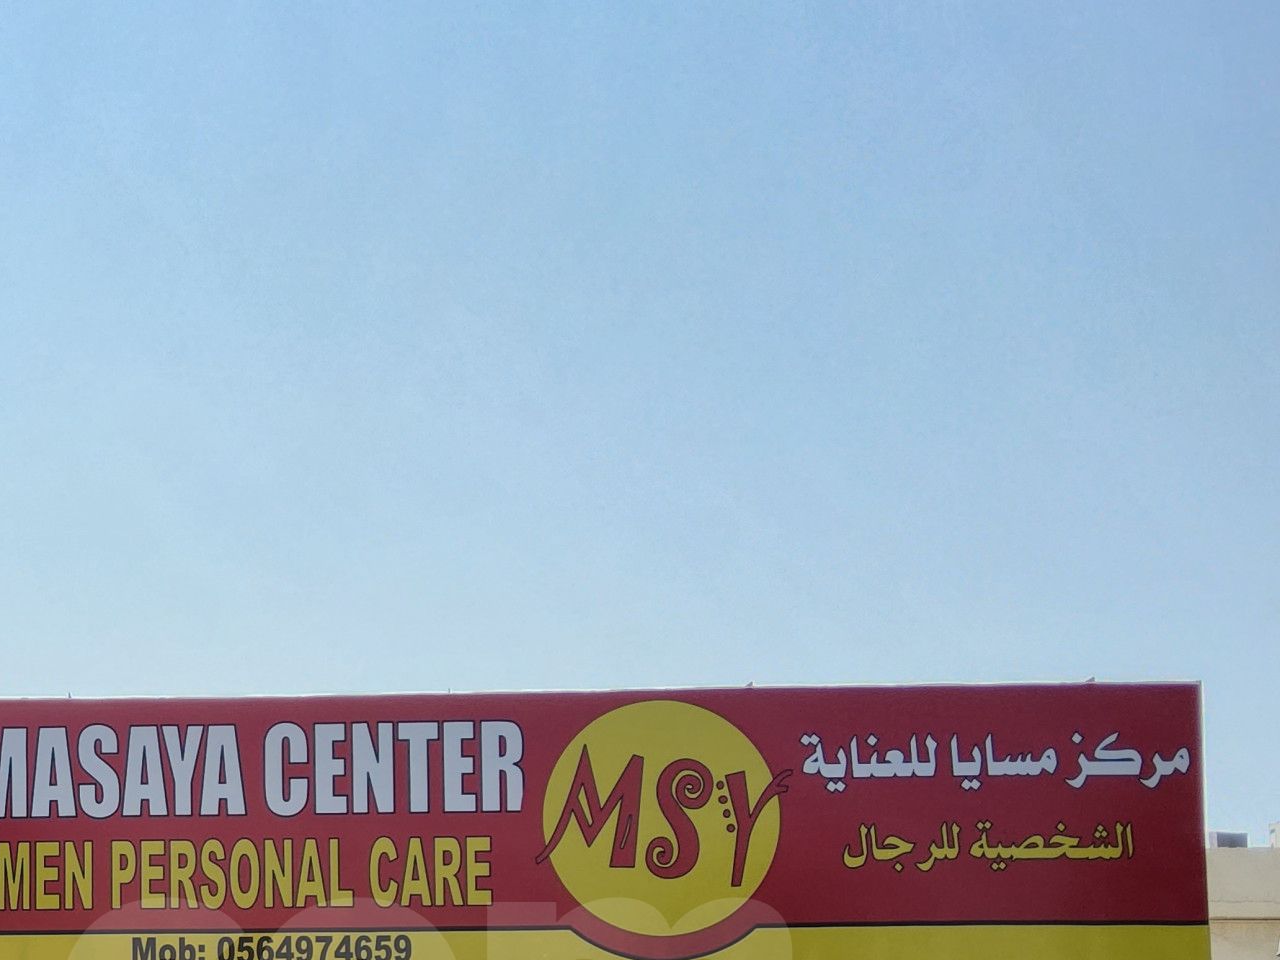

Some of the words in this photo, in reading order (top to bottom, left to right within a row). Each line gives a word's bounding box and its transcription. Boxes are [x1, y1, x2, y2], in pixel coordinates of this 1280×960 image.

[264, 720, 524, 817] CENTER
[799, 733, 938, 793] للعناية
[949, 732, 1058, 791] مسايا
[1065, 732, 1191, 789] مركز
[535, 743, 792, 888] MSY
[112, 837, 355, 910] PERSONAL
[369, 835, 494, 907] CARE
[842, 821, 961, 872] للرجال
[969, 820, 1135, 871] الشخصية
